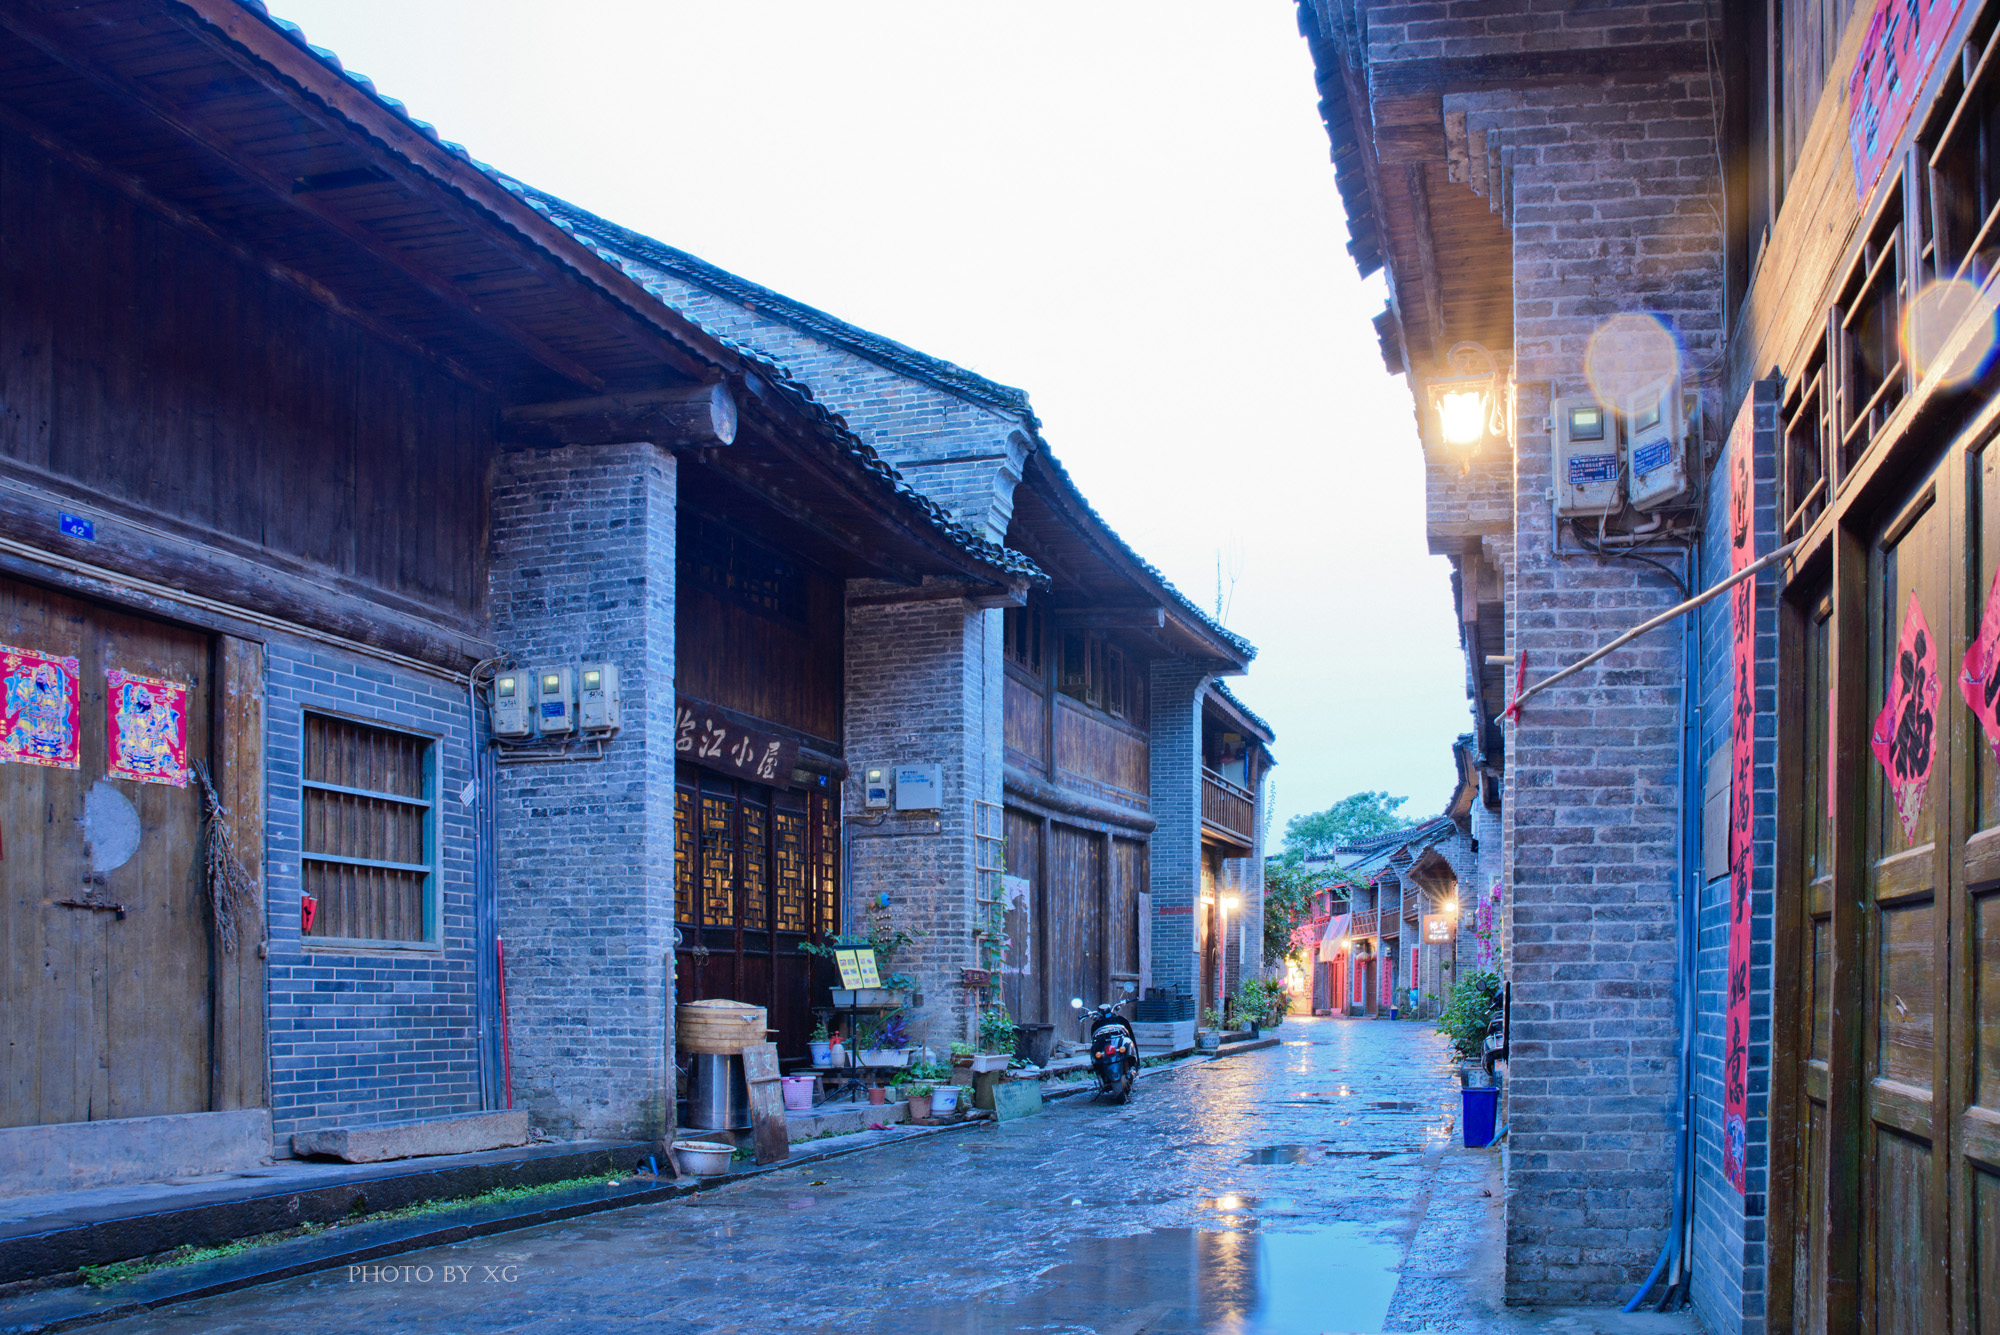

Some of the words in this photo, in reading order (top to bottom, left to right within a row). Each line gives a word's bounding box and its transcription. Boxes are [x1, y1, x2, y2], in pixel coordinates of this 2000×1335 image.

[70, 525, 85, 537] 42
[674, 706, 782, 779] 临江小屋
